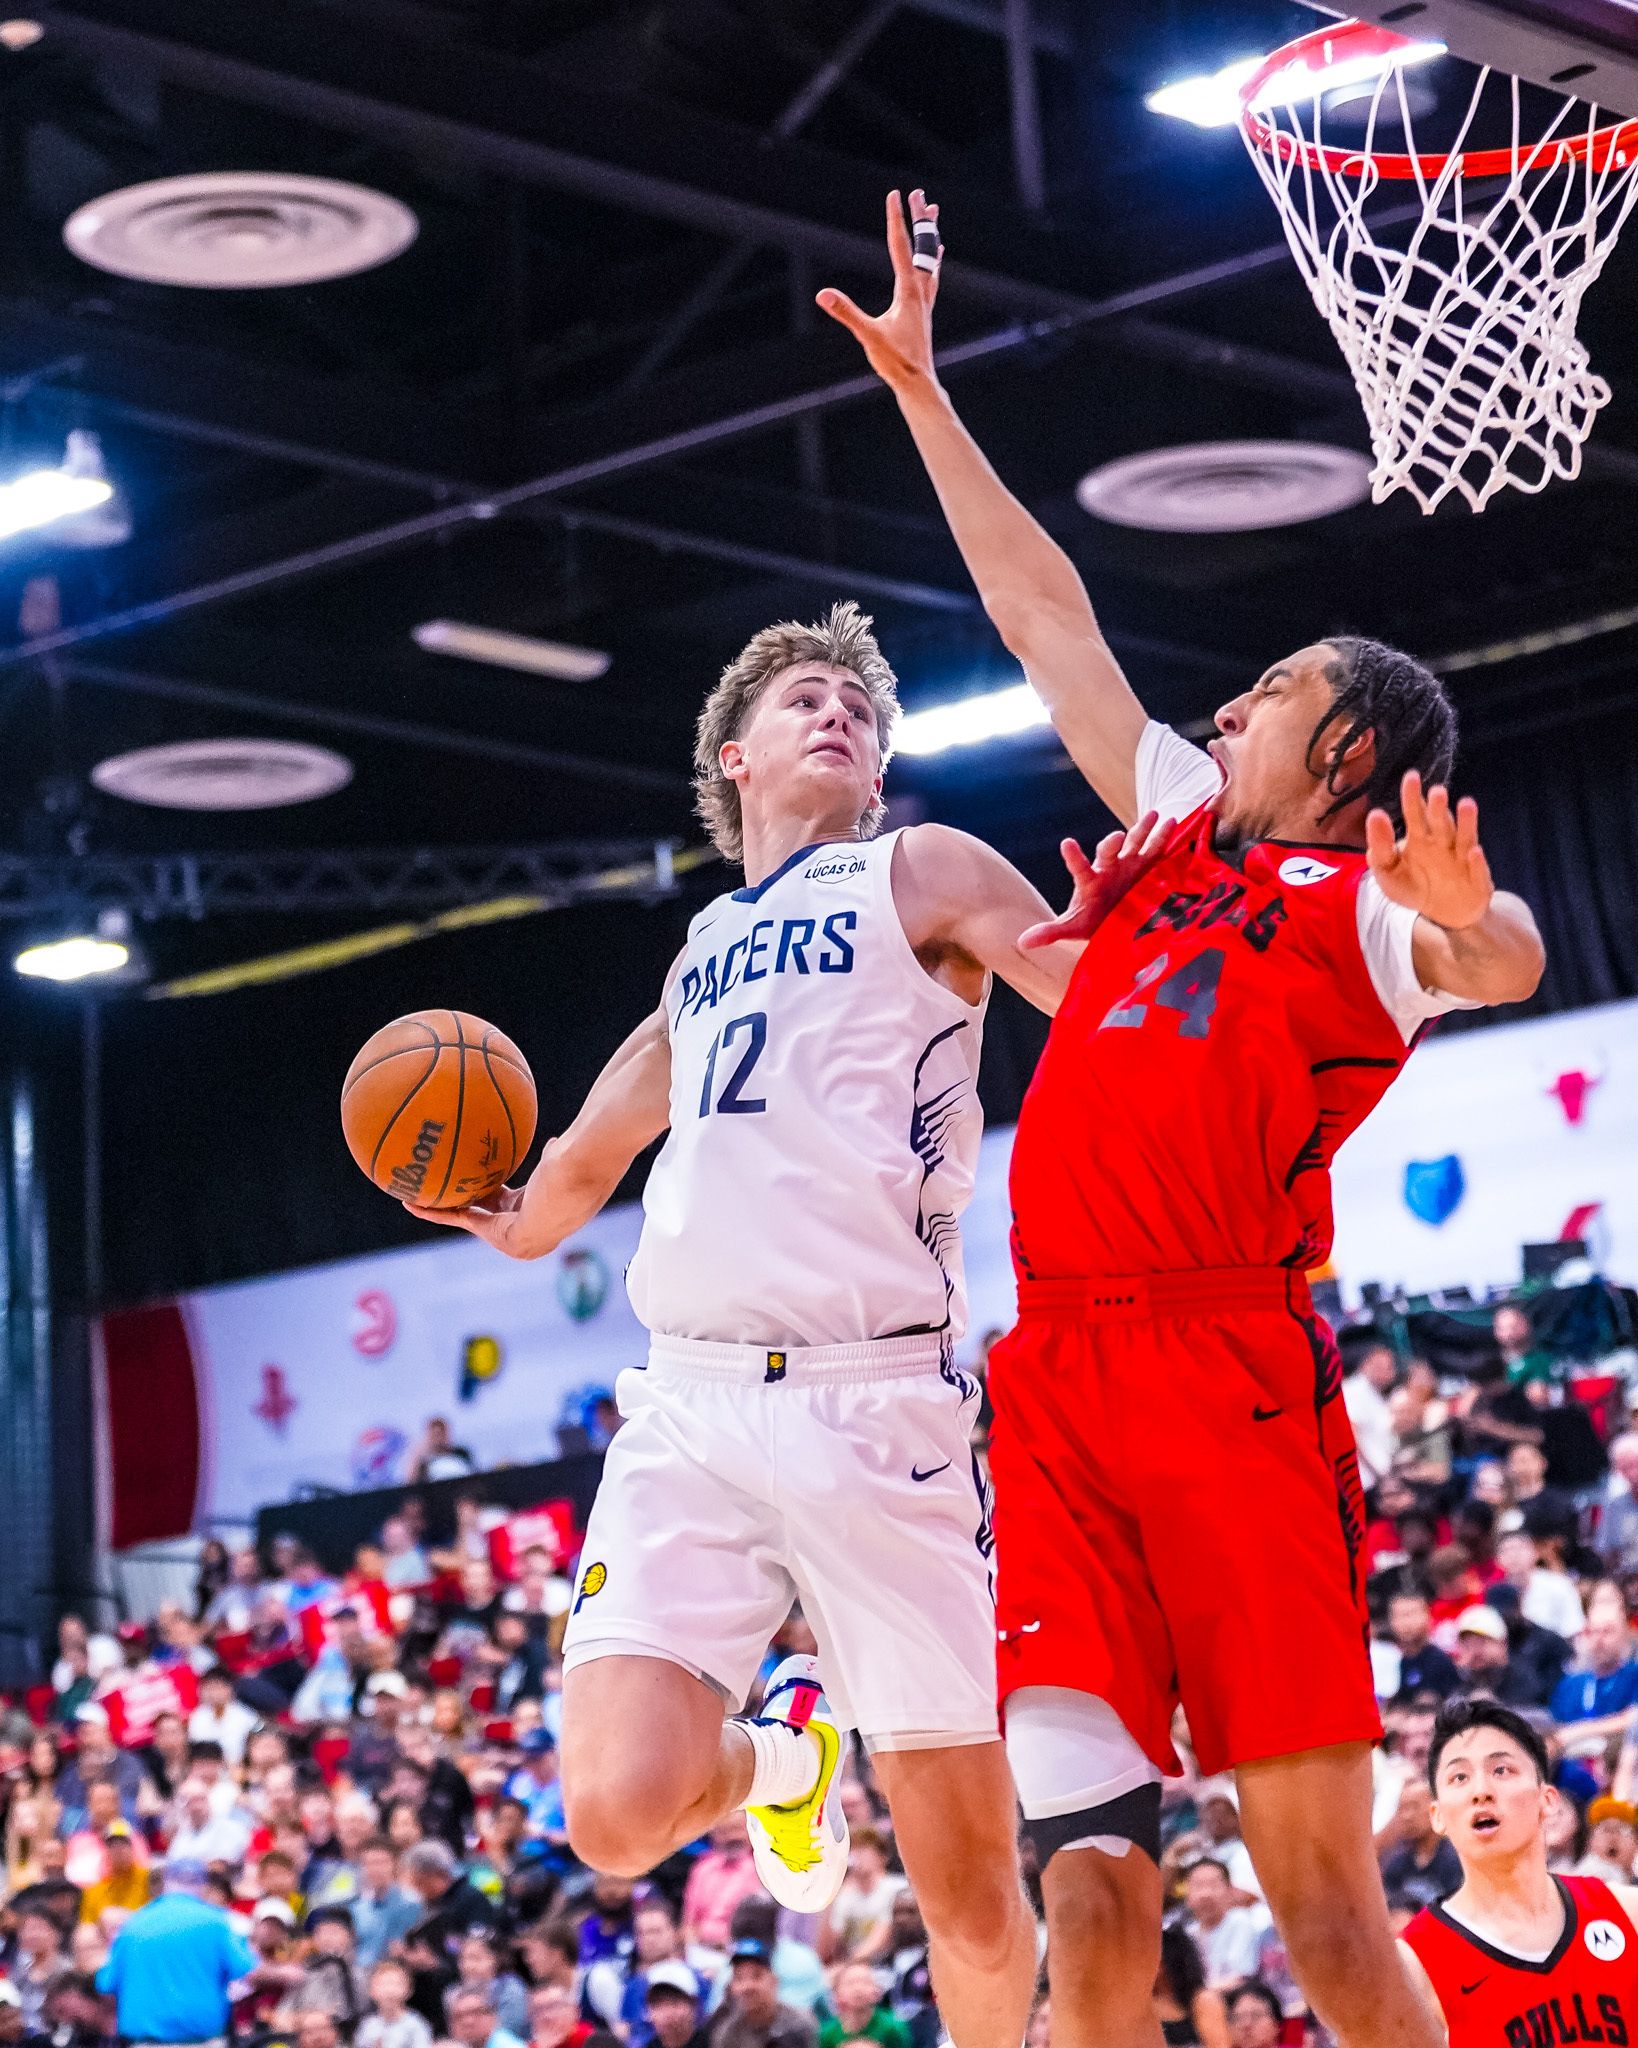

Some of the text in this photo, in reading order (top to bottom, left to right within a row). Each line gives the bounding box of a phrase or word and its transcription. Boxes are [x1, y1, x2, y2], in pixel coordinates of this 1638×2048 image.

[804, 859, 867, 879] LUCAS OIL
[674, 910, 857, 1033] PACERS
[1097, 949, 1225, 1039] 24
[698, 1011, 767, 1119] 12
[1504, 1993, 1628, 2048] BULLS
